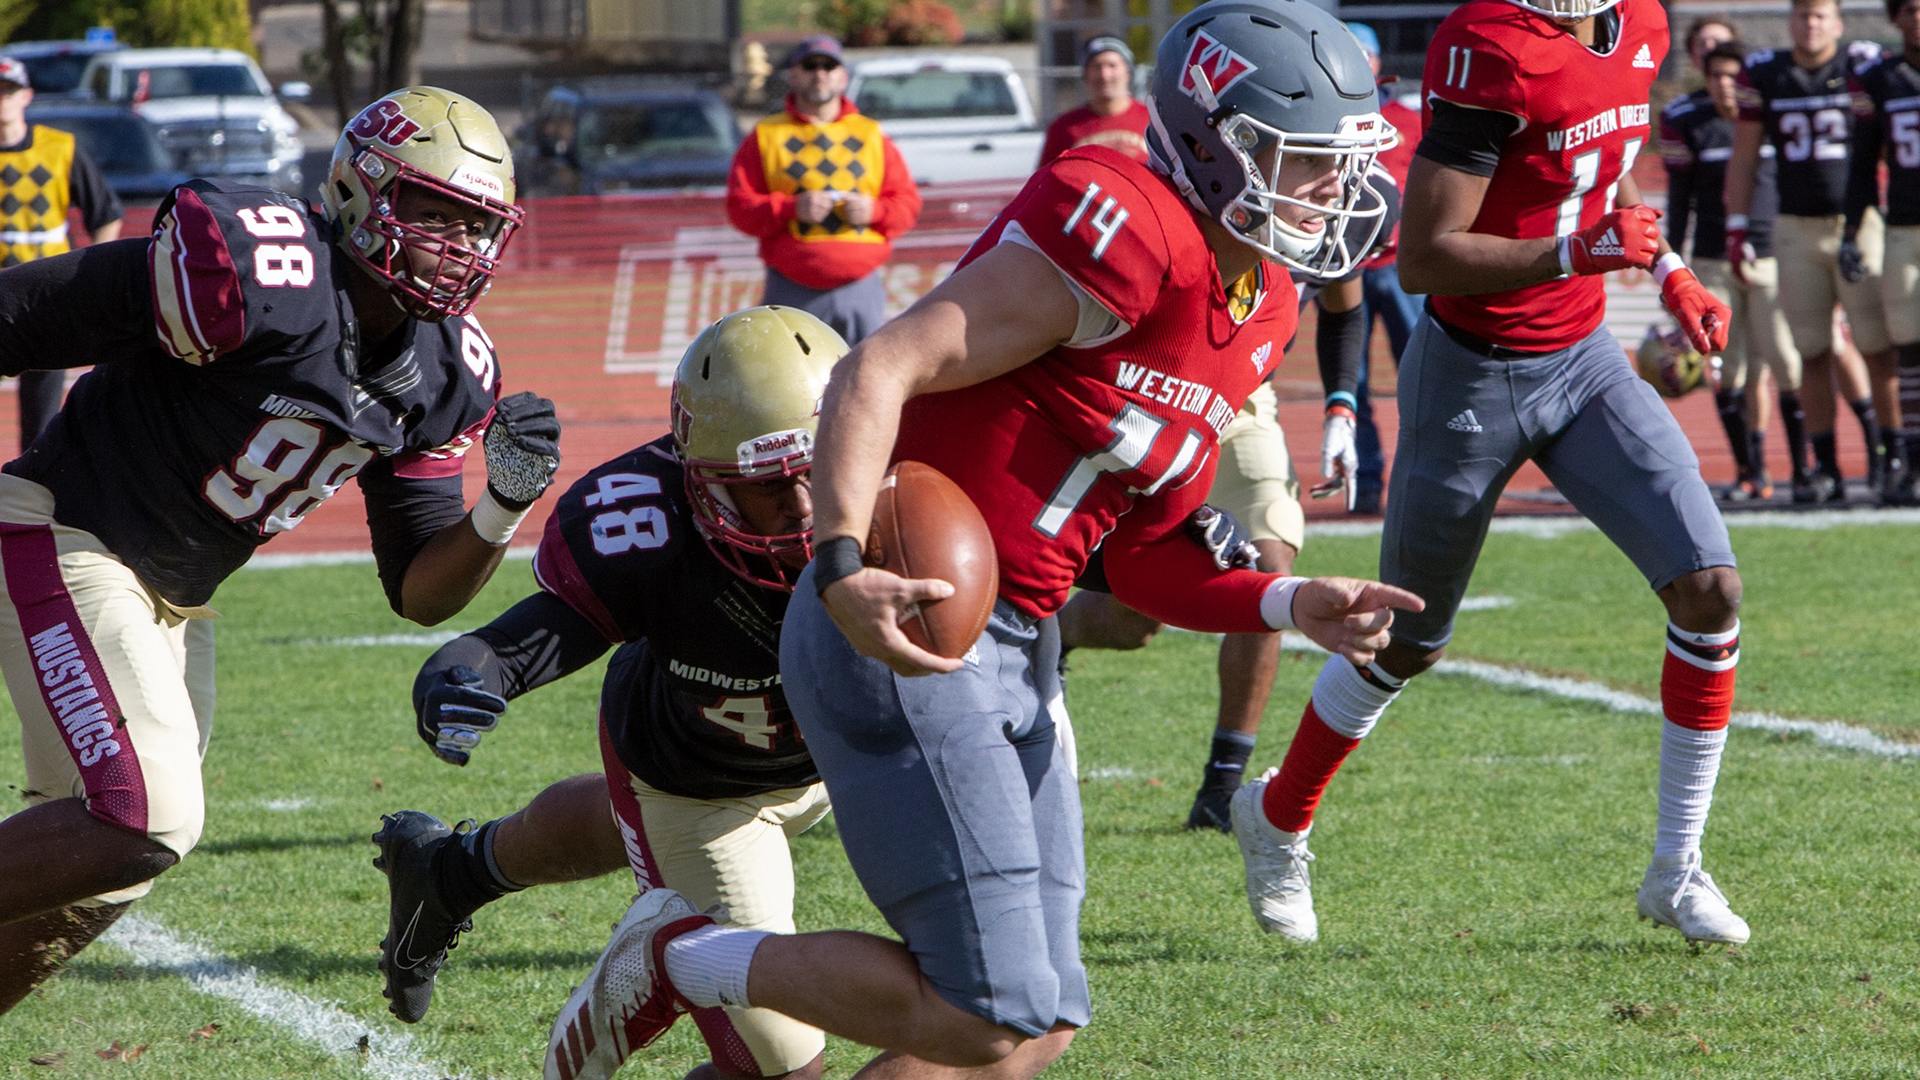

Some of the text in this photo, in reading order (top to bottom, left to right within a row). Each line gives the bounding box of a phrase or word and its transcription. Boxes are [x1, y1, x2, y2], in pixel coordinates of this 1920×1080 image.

[1445, 45, 1472, 90] 11
[1546, 107, 1618, 151] WESTERN
[1779, 109, 1848, 162] 32
[235, 205, 315, 288] 98
[1062, 180, 1130, 262] 14
[1591, 245, 1625, 256] adidas
[1115, 360, 1213, 416] WESTERN
[753, 433, 797, 454] Riddell
[1446, 420, 1483, 433] adidas
[201, 416, 375, 537] 98
[575, 472, 670, 557] 48
[29, 621, 121, 767] MUSTANGS
[698, 694, 784, 753] 4
